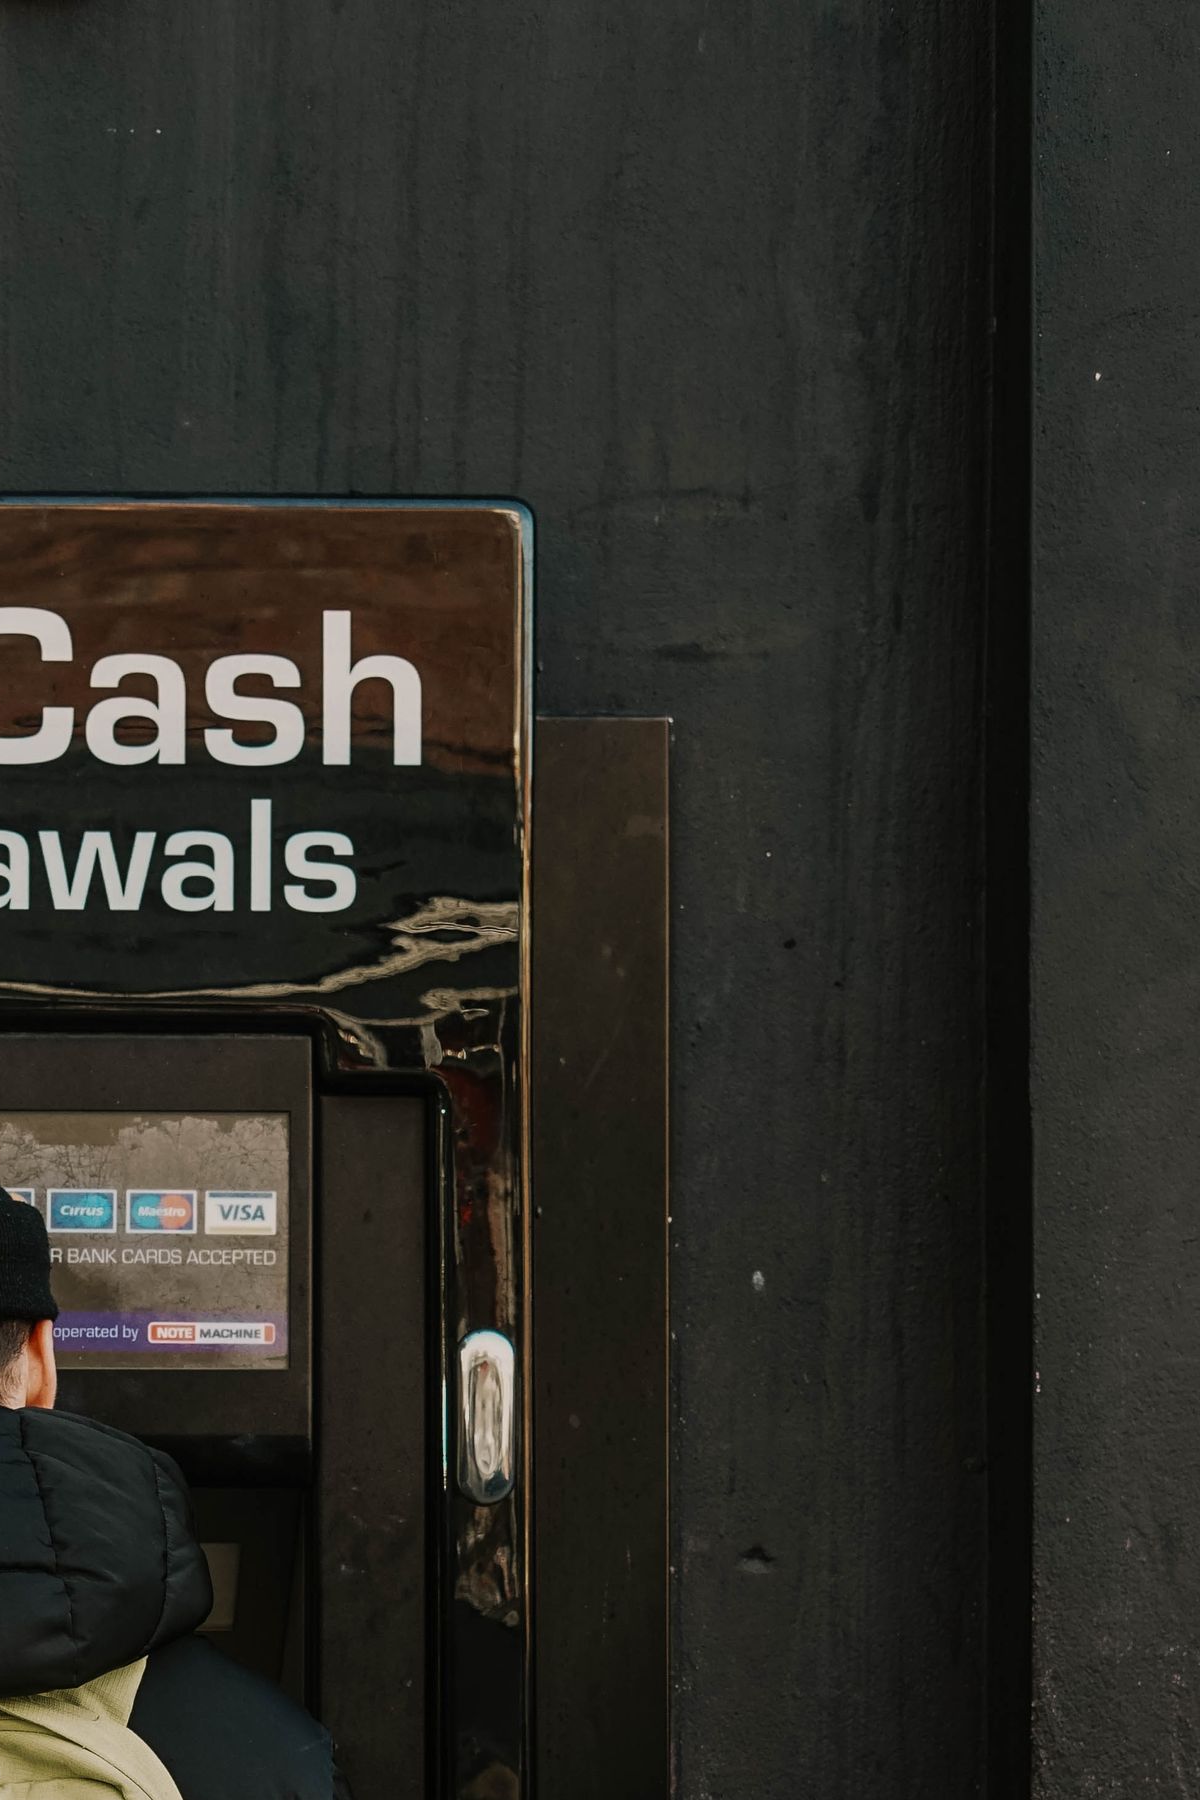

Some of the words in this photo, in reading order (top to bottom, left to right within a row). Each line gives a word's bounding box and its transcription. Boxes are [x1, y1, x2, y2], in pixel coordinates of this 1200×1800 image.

[60, 1204, 104, 1217] Cirrus
[137, 1205, 187, 1218] Maestro
[218, 1203, 266, 1221] VISA
[67, 1247, 117, 1264] BANK
[121, 1248, 183, 1265] CARDS
[186, 1249, 277, 1266] ACCEPTED
[53, 1324, 119, 1342] operated
[122, 1324, 139, 1342] by
[156, 1327, 193, 1339] NOTE
[199, 1328, 262, 1340] MACHINE
